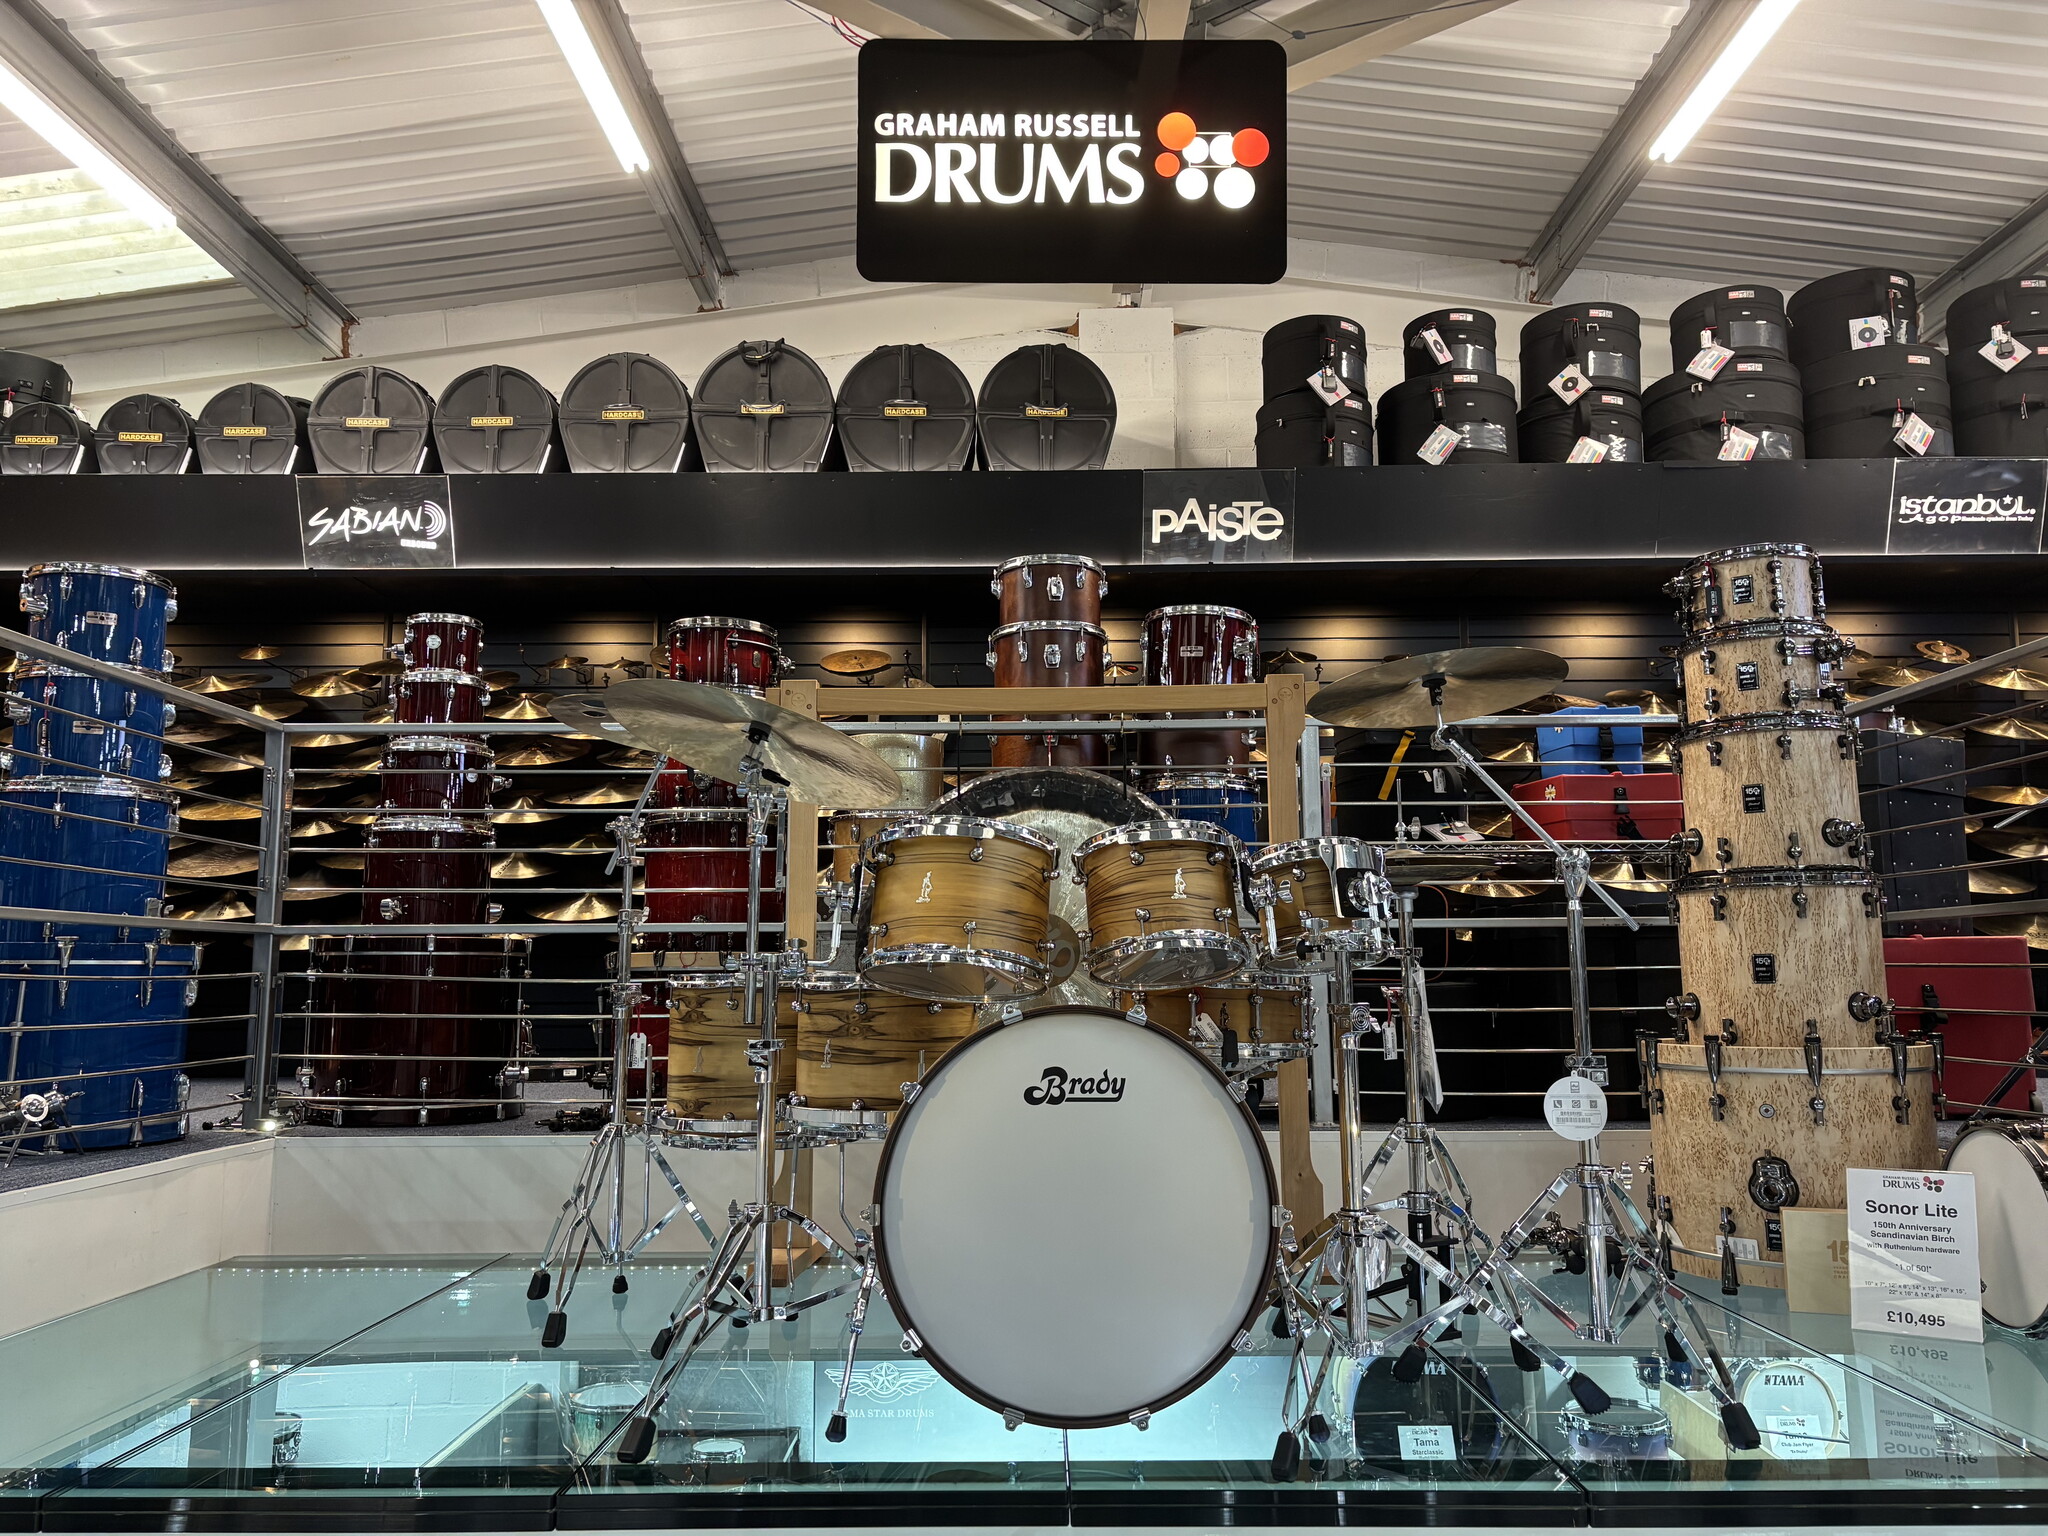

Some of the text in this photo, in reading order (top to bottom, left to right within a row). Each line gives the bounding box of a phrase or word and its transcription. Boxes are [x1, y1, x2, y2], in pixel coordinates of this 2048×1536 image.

[874, 113, 1141, 138] GRAHAM RUSSELL
[875, 142, 1145, 205] DRUMS
[347, 418, 388, 426] HARDCASE
[17, 436, 56, 444] HARDCASE
[120, 434, 162, 442] HARDCASE
[308, 506, 423, 546] SABIAN
[1024, 1066, 1126, 1106] Brady
[1882, 1180, 1920, 1189] DRUMS
[1865, 1200, 1958, 1218] Sonor Lite
[1873, 1221, 1951, 1234] 150th Anniversary
[1870, 1230, 1955, 1243] Scandinavian Birch
[1884, 1243, 1923, 1252] Ruthenium
[1925, 1246, 1960, 1255] hardware
[1887, 1310, 1945, 1327] £10,495
[1772, 1375, 1805, 1386] TAMA
[868, 1409, 895, 1418] STAR
[897, 1409, 934, 1418] DRUMS
[1413, 1438, 1440, 1447] Tama
